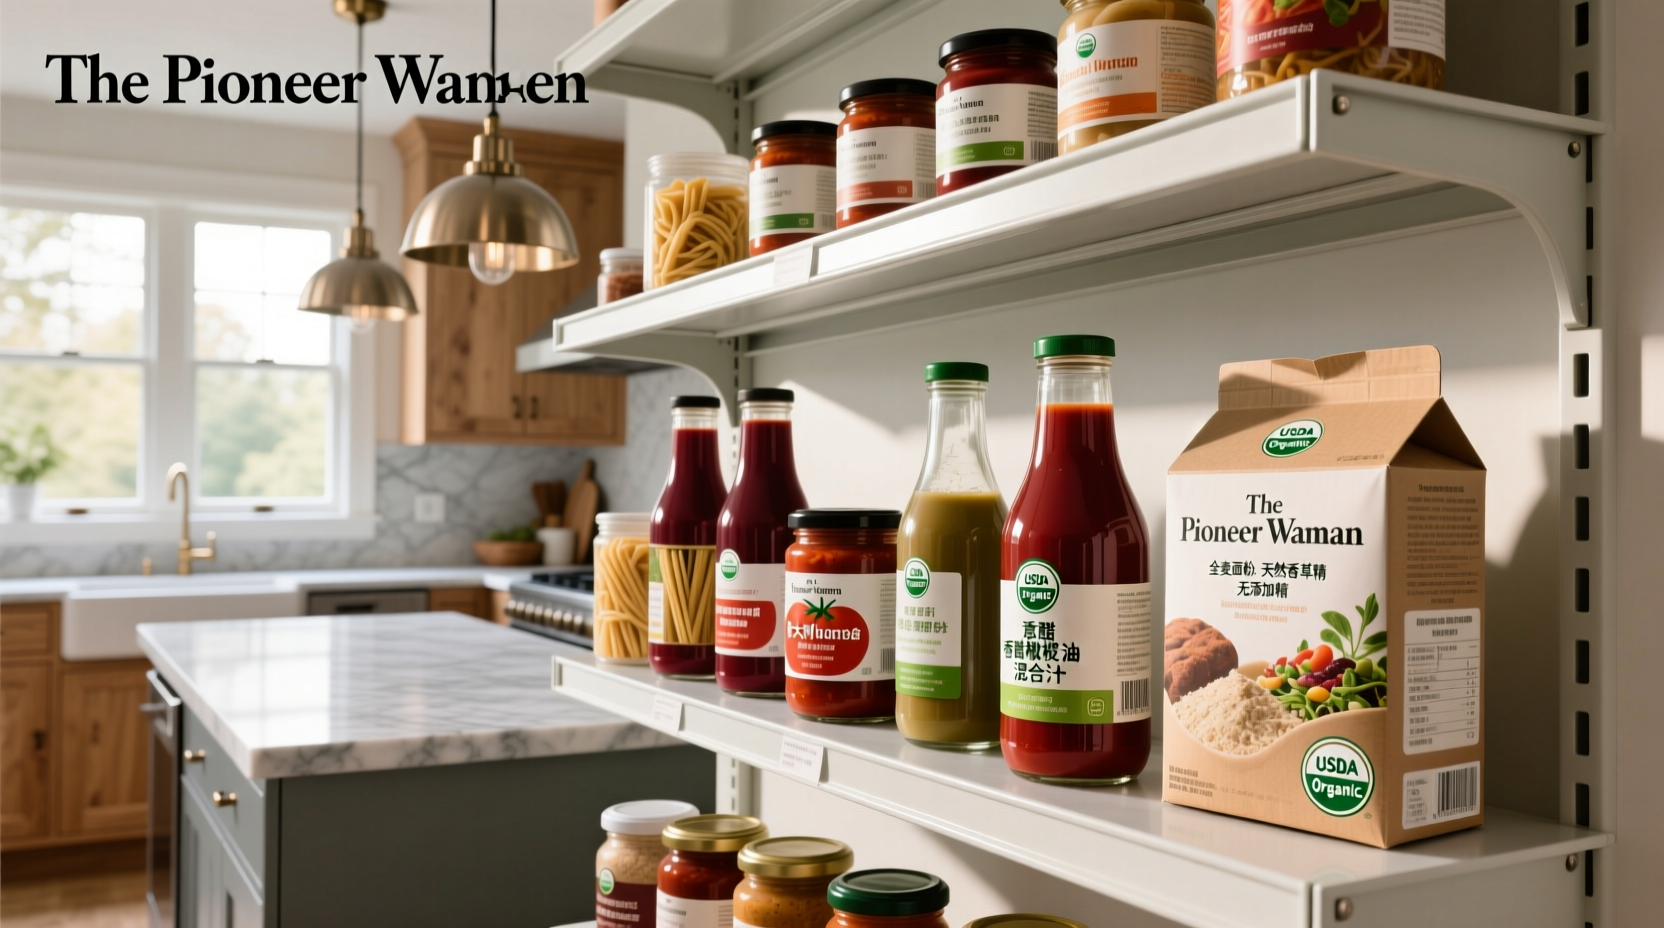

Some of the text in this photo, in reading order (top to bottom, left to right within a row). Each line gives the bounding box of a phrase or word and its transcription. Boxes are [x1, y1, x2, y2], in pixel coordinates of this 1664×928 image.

[1246, 493, 1283, 515] The
[1179, 516, 1364, 546] Pioneer Waman
[1316, 755, 1359, 777] USDA
[1311, 777, 1363, 799] Organic
